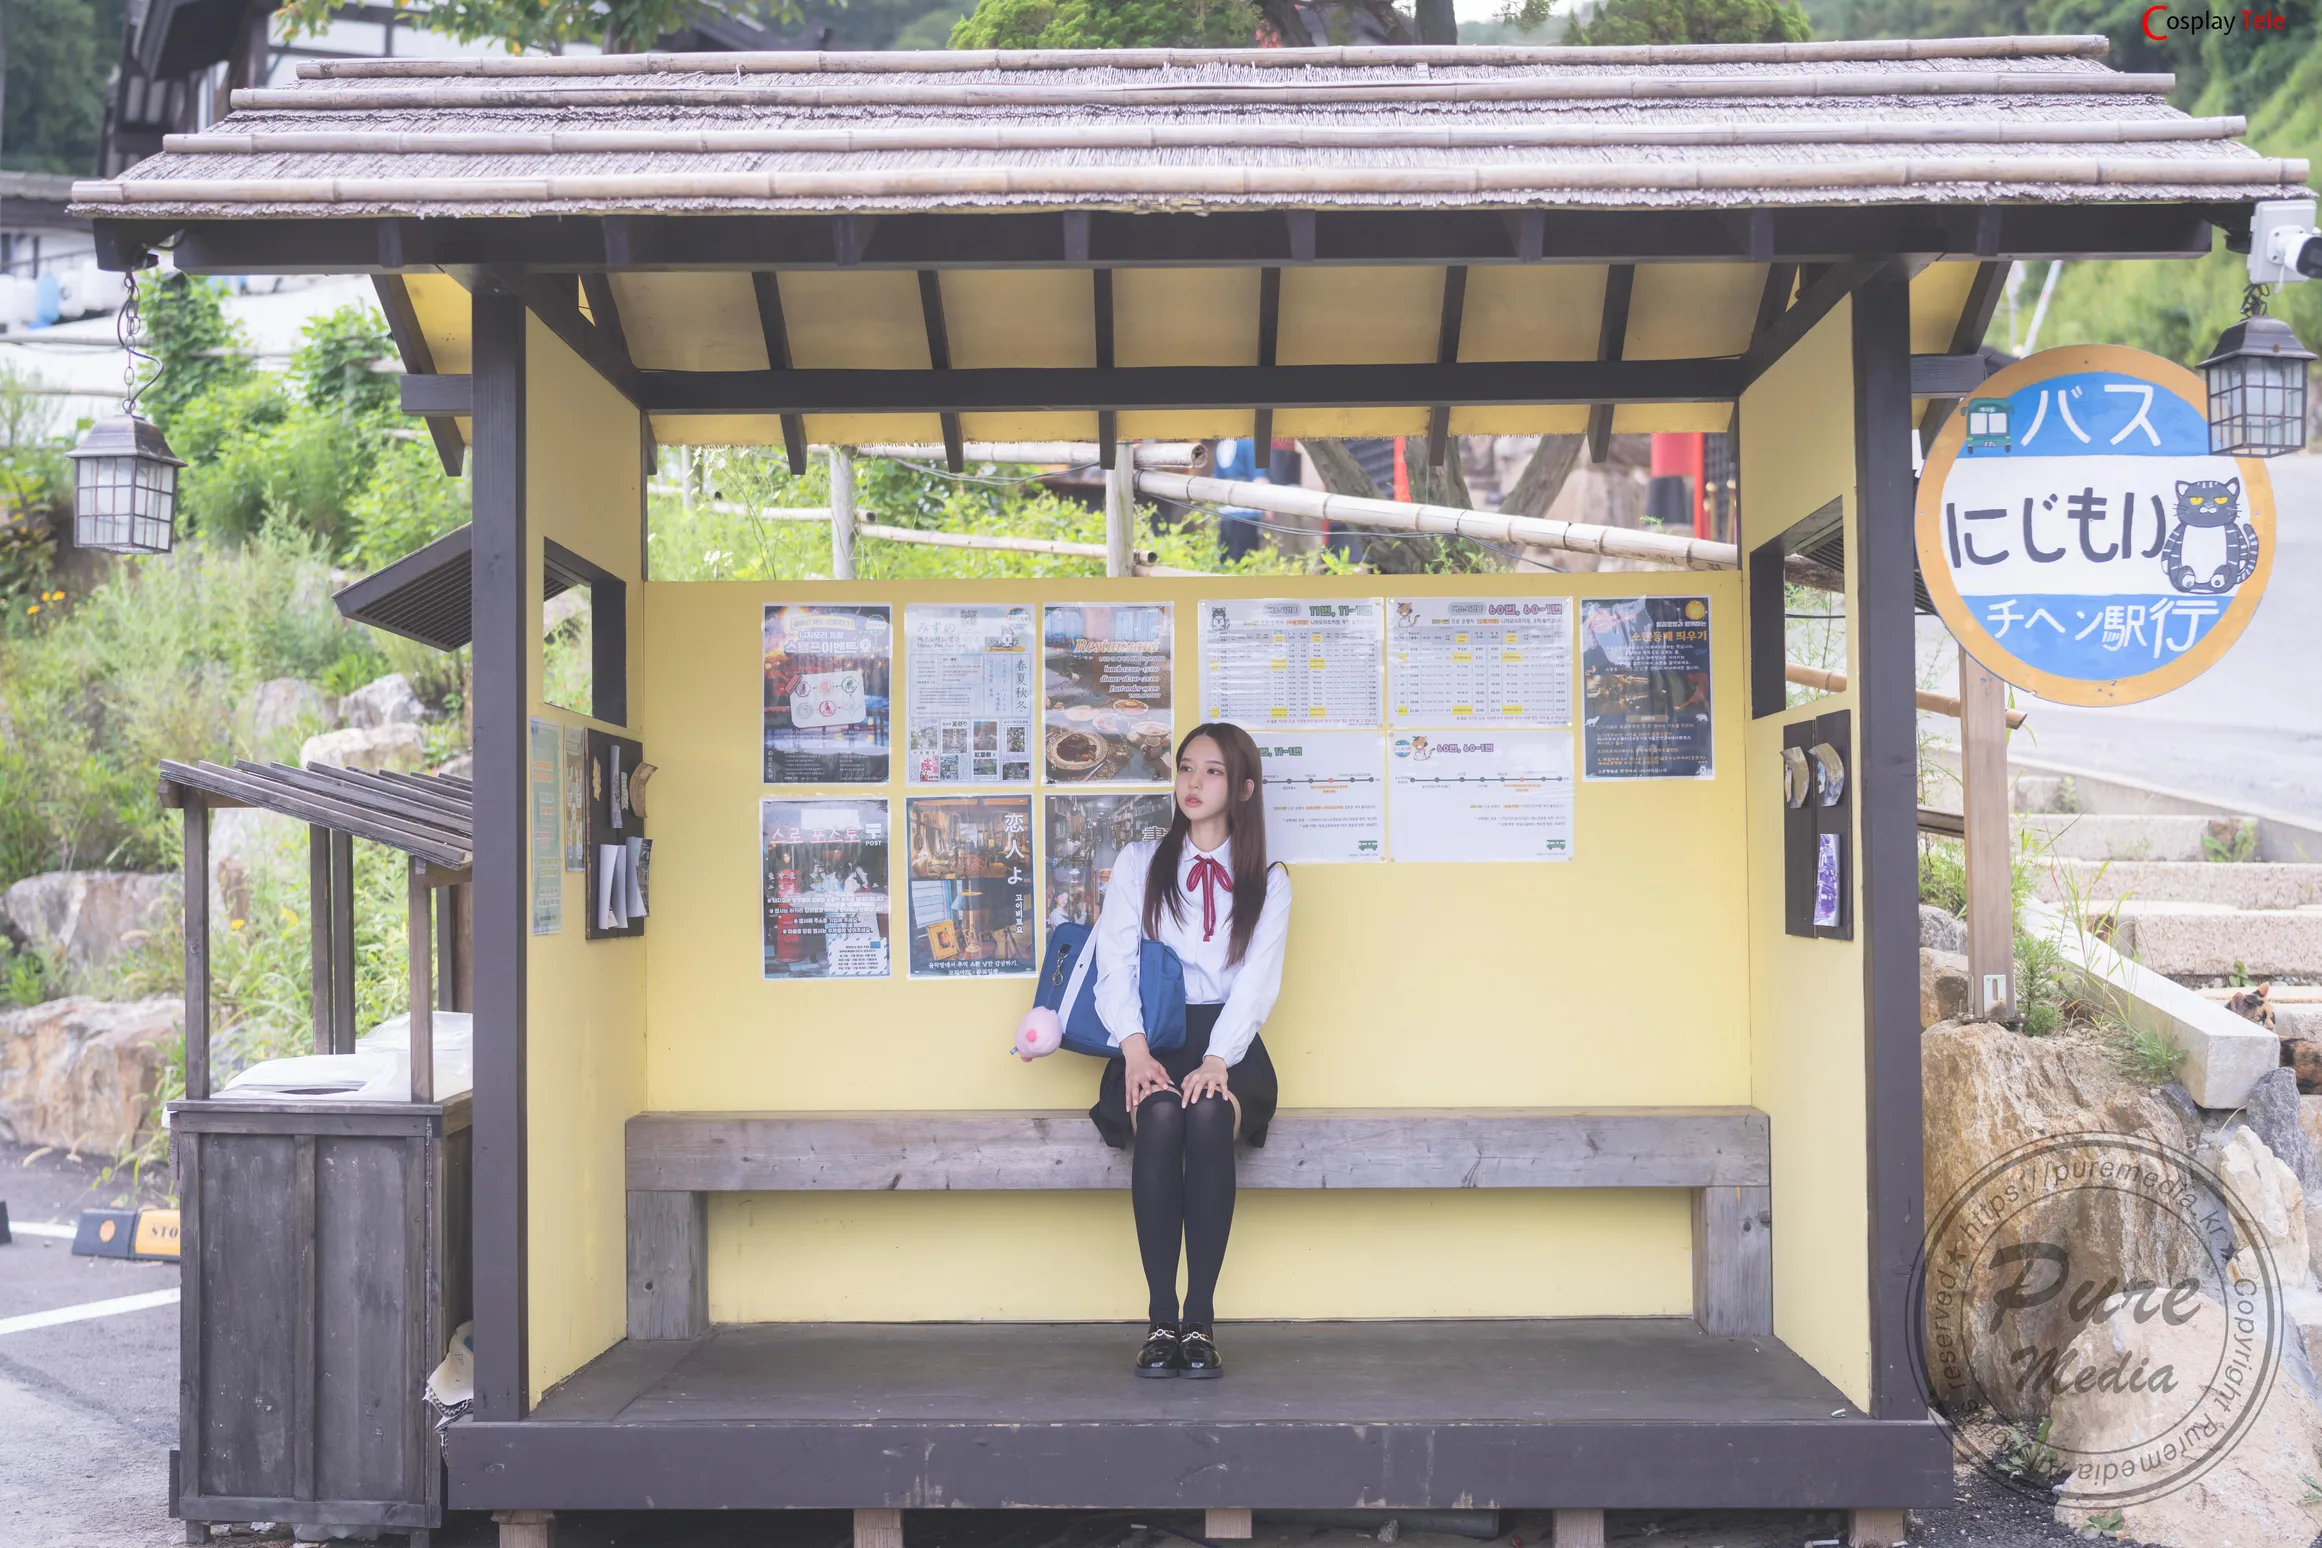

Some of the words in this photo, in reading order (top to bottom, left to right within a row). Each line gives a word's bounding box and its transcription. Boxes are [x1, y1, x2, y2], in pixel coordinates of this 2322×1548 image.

[2020, 384, 2161, 446] バス
[1946, 487, 2167, 568] にじもり
[1488, 604, 1520, 616] 60번,
[1523, 604, 1563, 615] 60-1번
[1676, 631, 1708, 641] 띄우기
[1987, 597, 2219, 658] チヘン駅行
[1073, 638, 1160, 653] Restaurant
[1016, 659, 1028, 712] 春夏秋冬
[1274, 747, 1302, 756] 11-1번
[1436, 744, 1461, 753] 60번,
[1463, 743, 1494, 752] 60-1번
[810, 827, 861, 844] 포스토
[1004, 812, 1025, 885] 恋人よ
[1015, 894, 1024, 934] 고이비토요
[151, 1225, 179, 1239] STO
